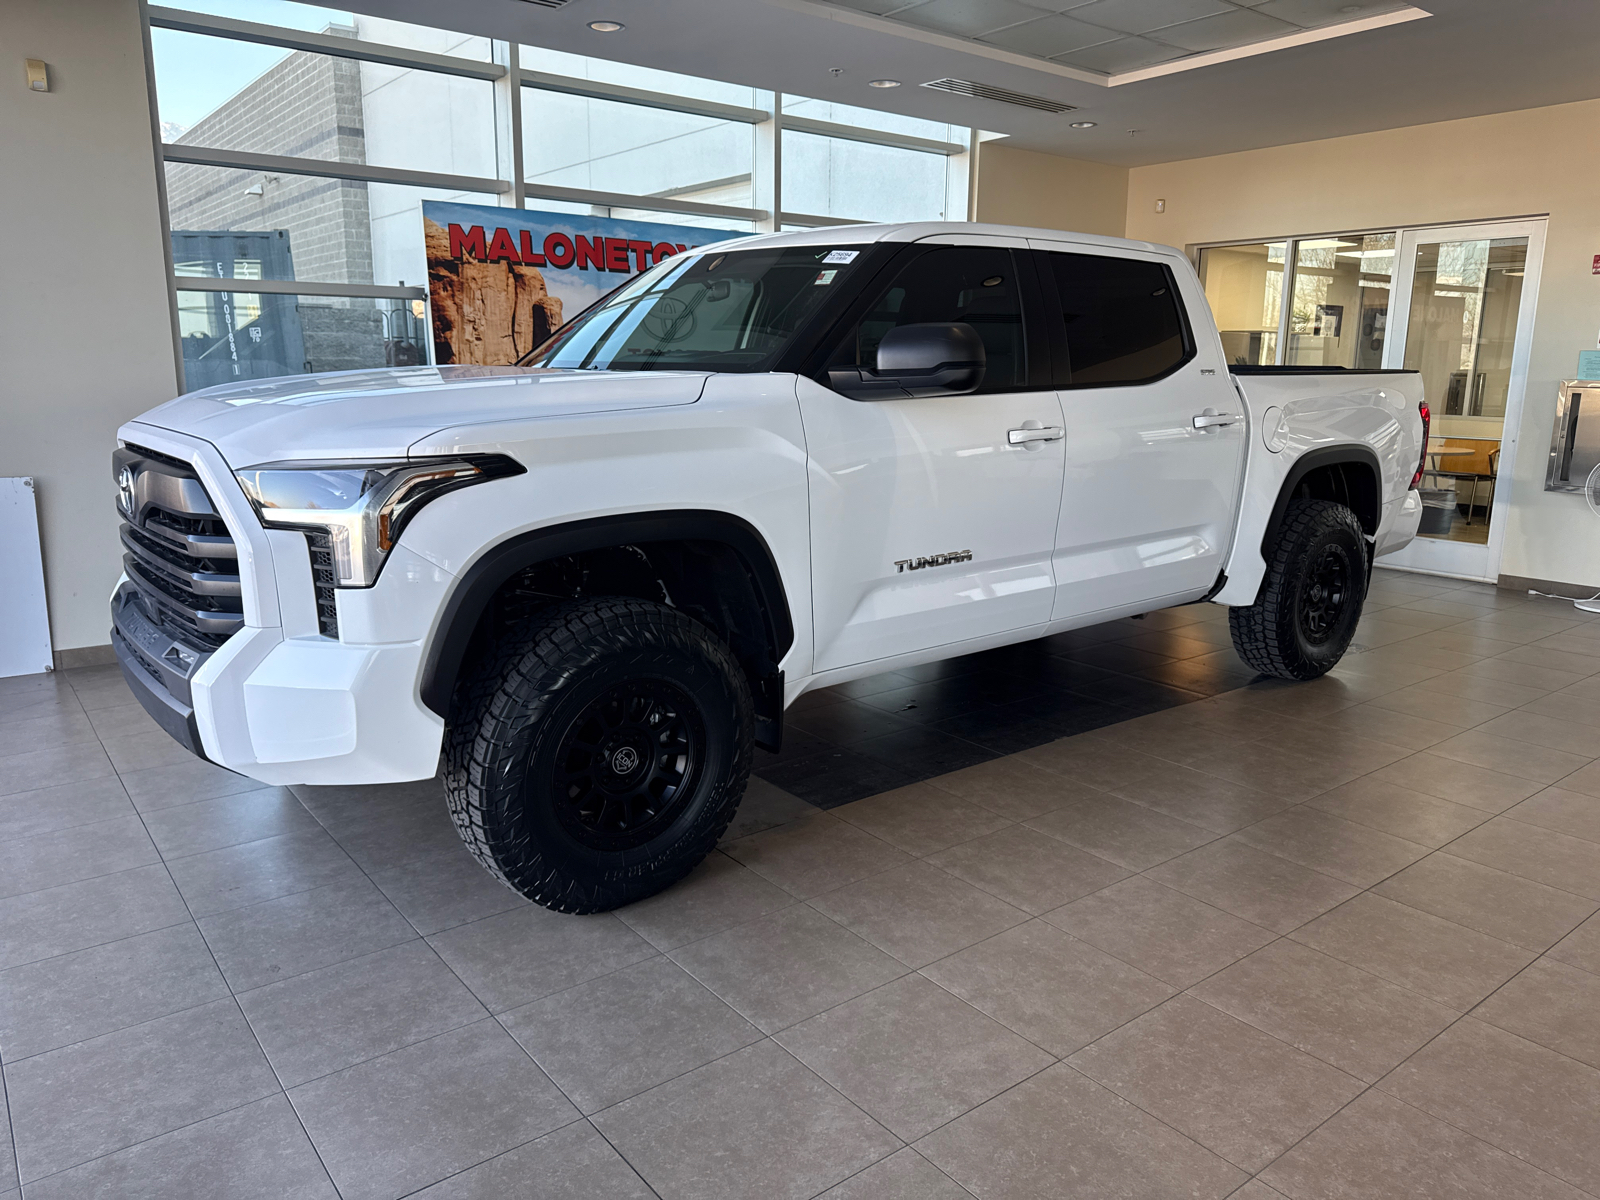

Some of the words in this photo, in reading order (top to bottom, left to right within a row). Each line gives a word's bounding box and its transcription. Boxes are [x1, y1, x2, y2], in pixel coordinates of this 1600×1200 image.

[447, 223, 699, 275] MALONETO
[893, 549, 973, 573] TUNDRA
[616, 752, 633, 768] ICON
